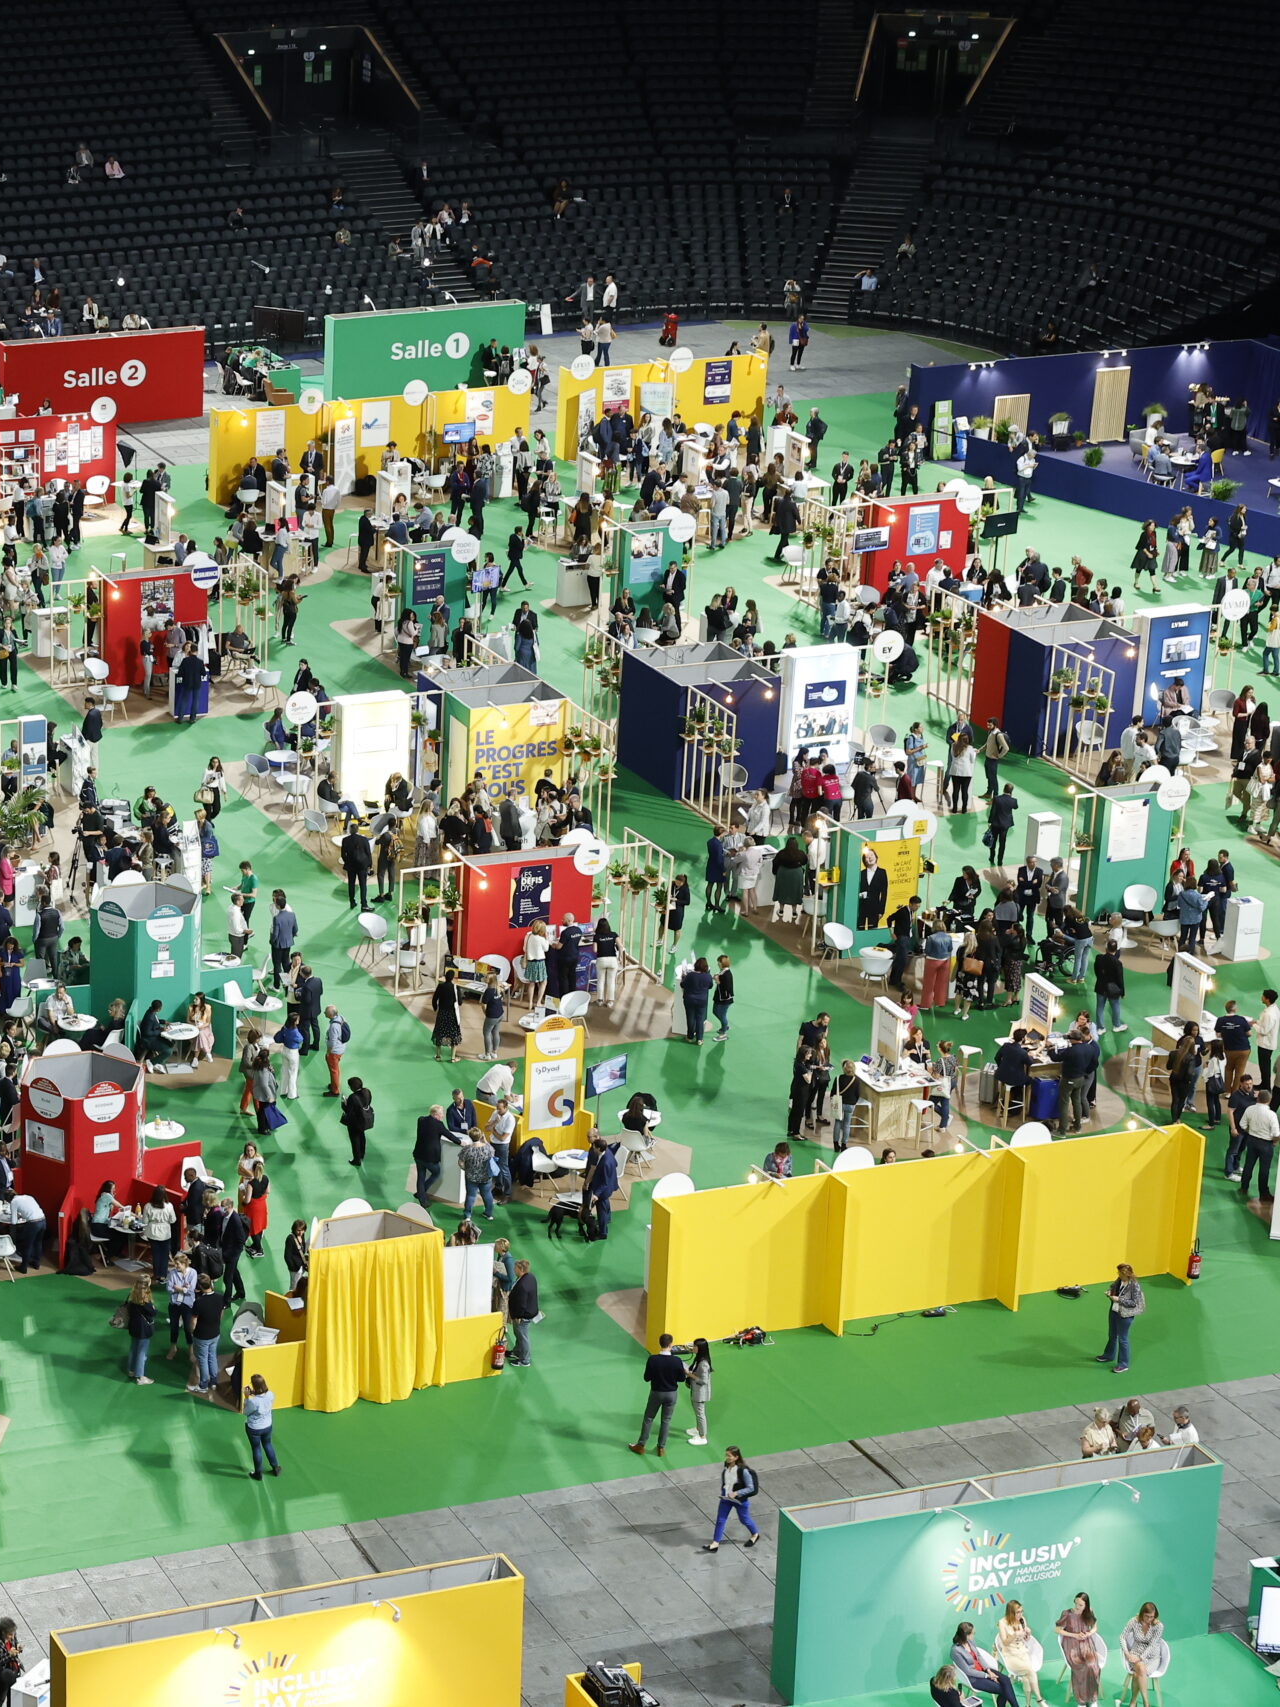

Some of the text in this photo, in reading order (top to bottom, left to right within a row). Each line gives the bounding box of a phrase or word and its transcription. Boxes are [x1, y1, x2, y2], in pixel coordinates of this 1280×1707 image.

[390, 339, 443, 360] Salle
[63, 366, 118, 388] Salle
[1171, 620, 1189, 629] LVMH
[882, 646, 893, 654] EY
[475, 729, 495, 747] LE
[475, 762, 523, 781] C'EST
[486, 780, 526, 798] OUS
[542, 1064, 560, 1075] Dyad
[1014, 1569, 1062, 1584] INCLUSION
[1015, 1561, 1061, 1576] HANDICAP
[968, 1569, 1013, 1592] DAY
